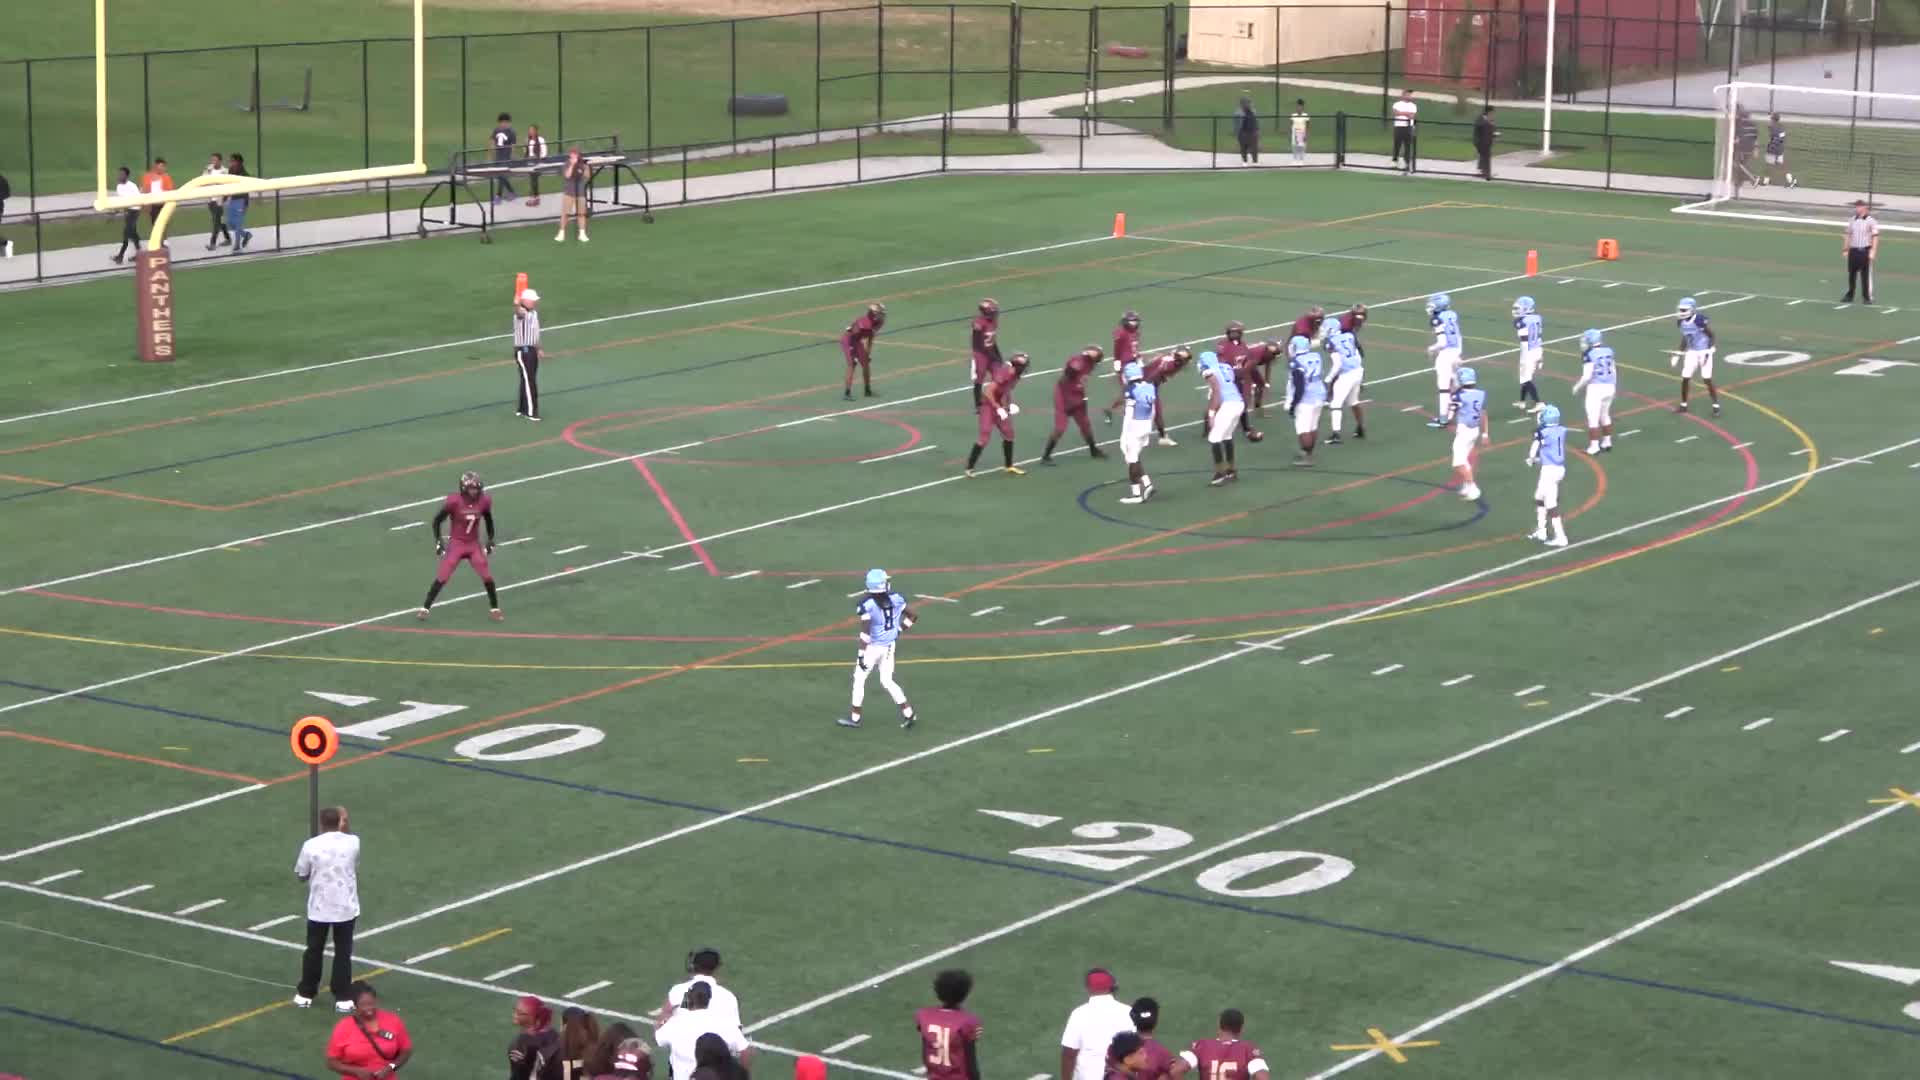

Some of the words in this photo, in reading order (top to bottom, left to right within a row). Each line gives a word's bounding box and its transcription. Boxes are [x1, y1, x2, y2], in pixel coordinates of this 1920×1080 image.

[148, 257, 172, 356] PANTHERS
[465, 514, 476, 534] 7
[927, 1023, 953, 1067] 31
